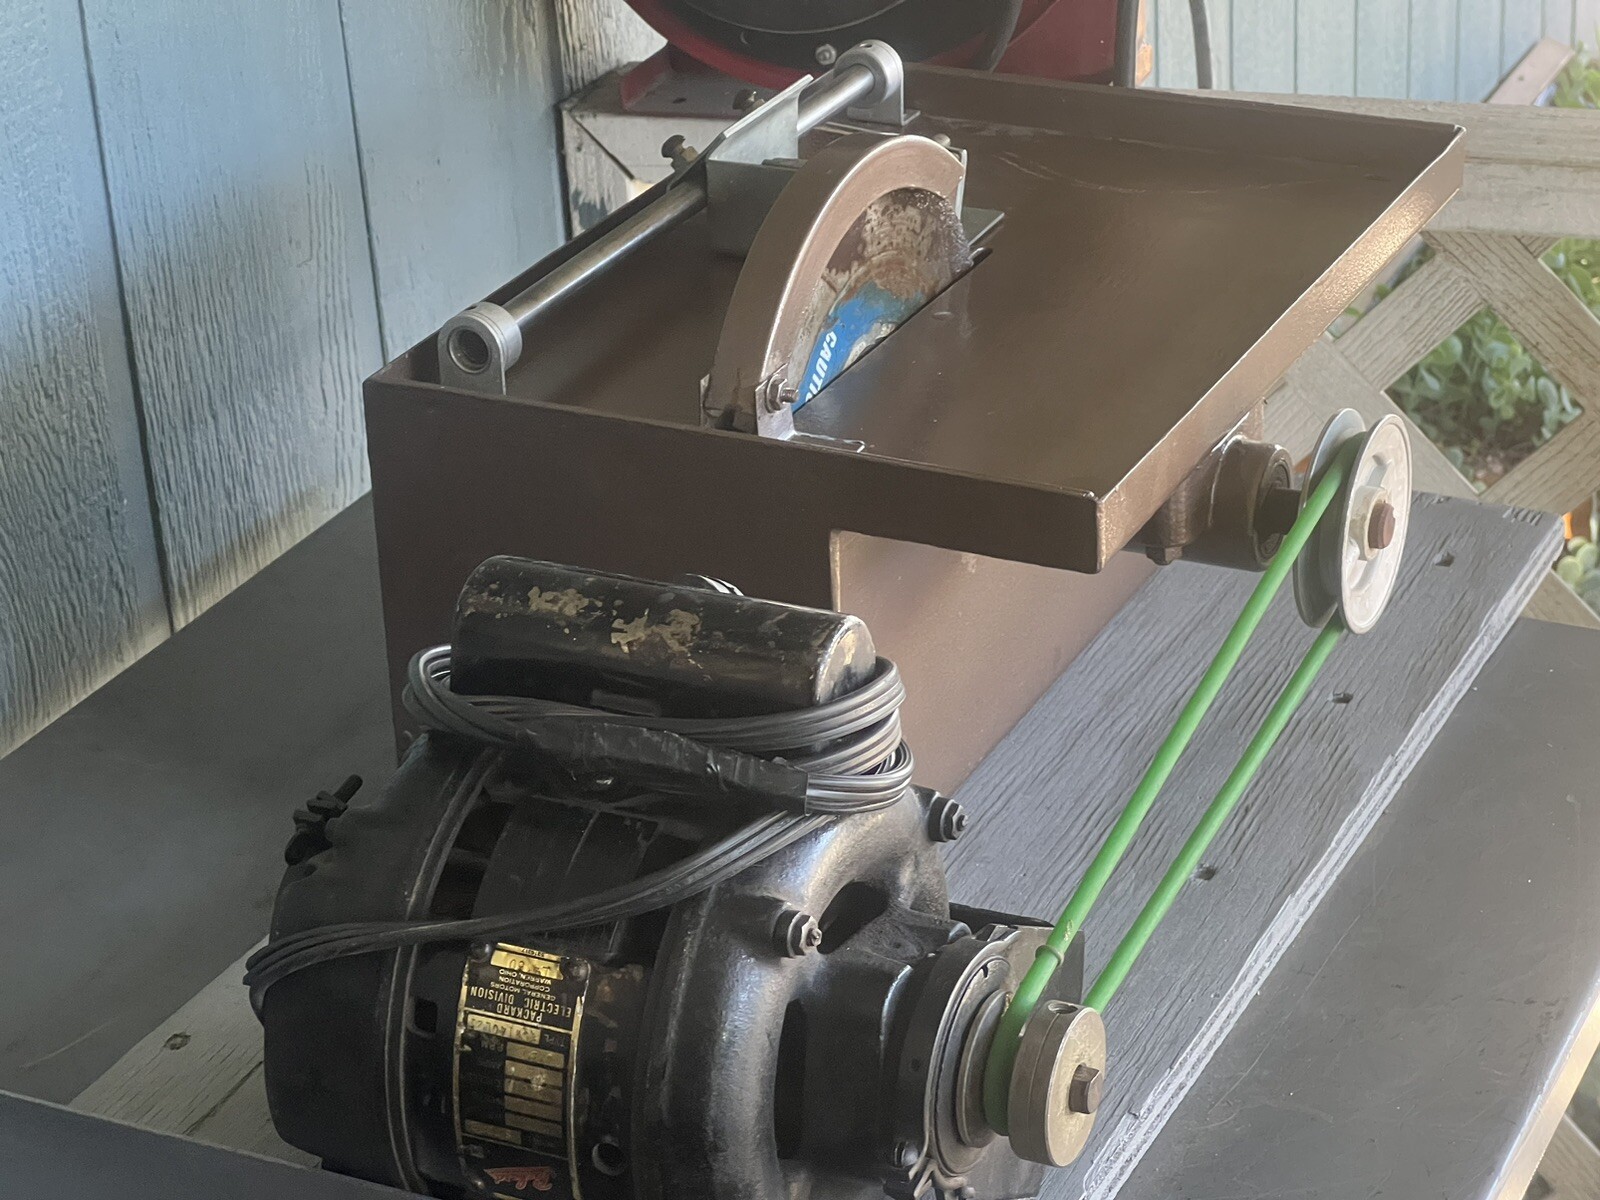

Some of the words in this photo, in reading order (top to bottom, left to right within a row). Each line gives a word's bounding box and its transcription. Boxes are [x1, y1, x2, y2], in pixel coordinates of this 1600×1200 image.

[499, 969, 517, 978] OHIO
[490, 982, 520, 993] MOTORS
[522, 989, 556, 1001] GENERAL
[470, 986, 515, 1005] DIVISION
[497, 1003, 543, 1022] PACKARD
[524, 997, 571, 1018] ELECTRIC
